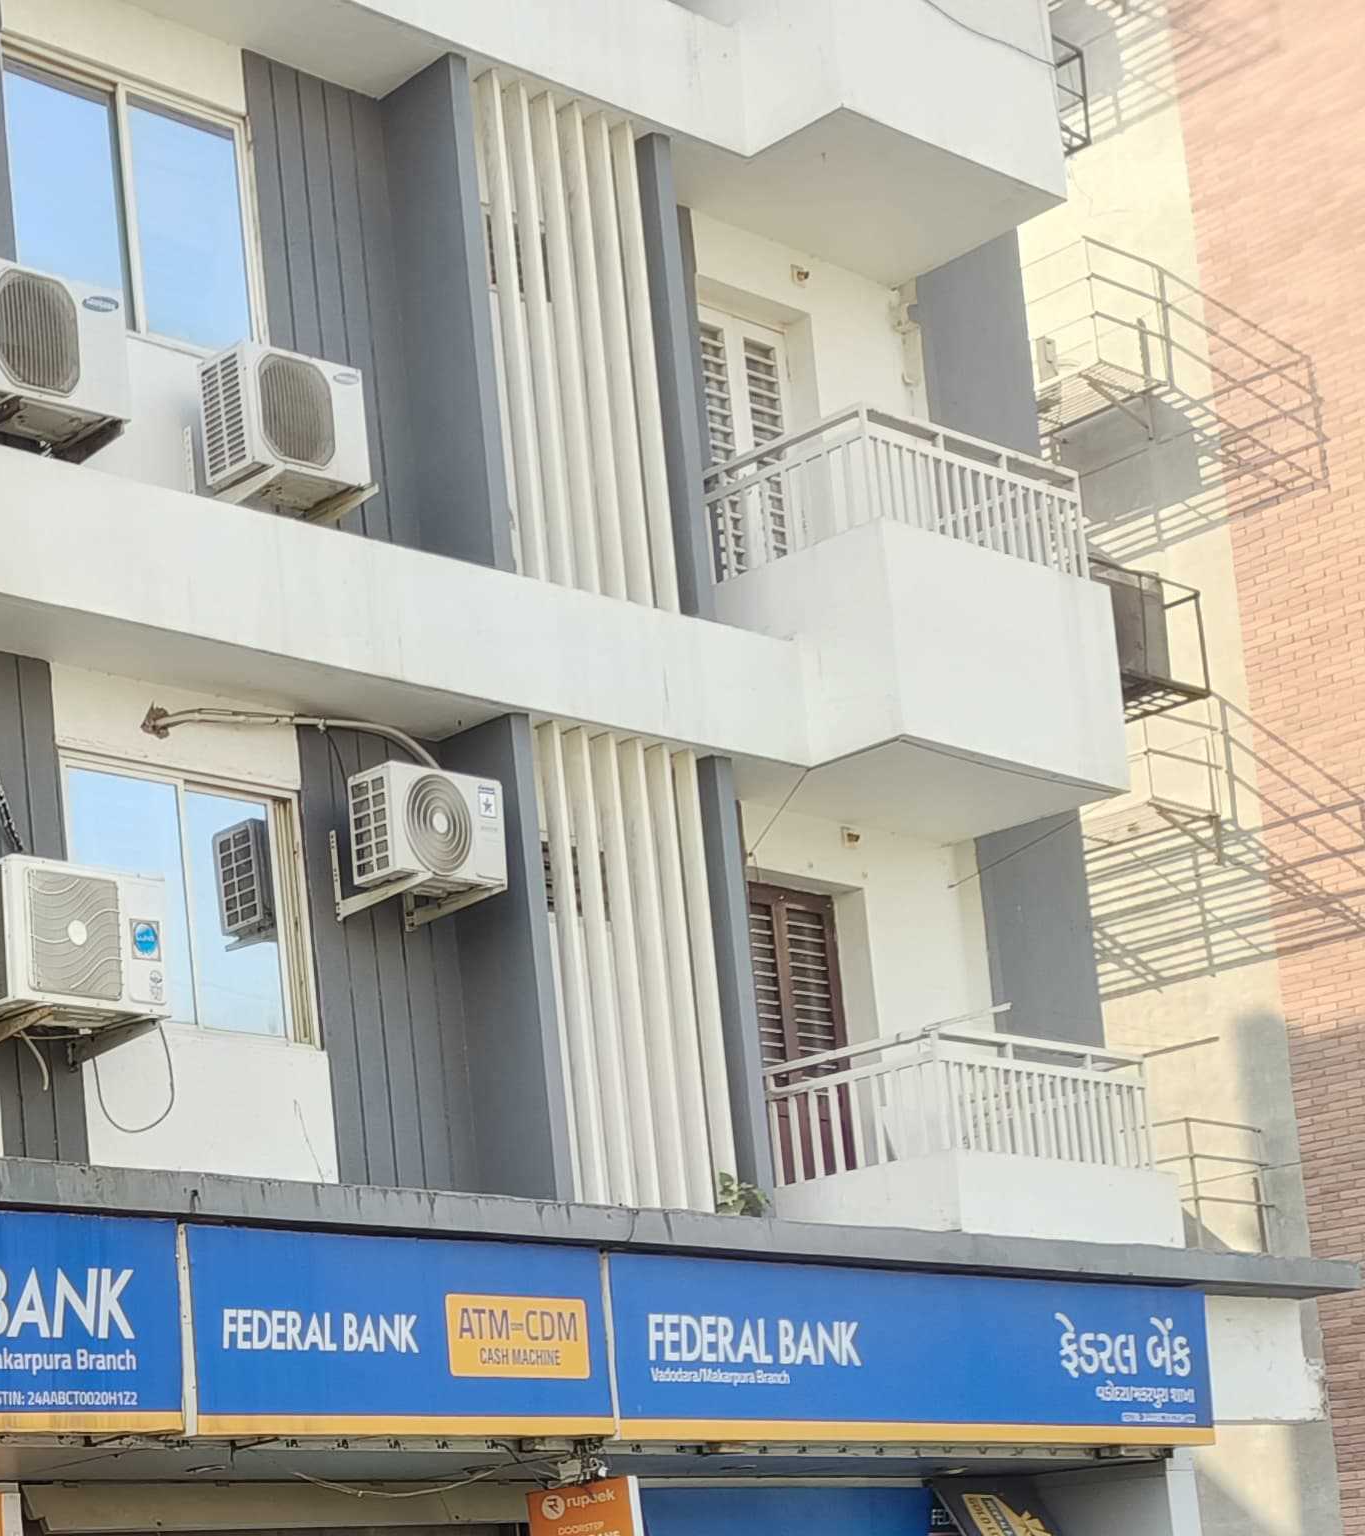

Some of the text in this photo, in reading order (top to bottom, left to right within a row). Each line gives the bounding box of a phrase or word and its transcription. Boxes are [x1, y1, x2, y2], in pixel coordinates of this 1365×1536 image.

[222, 1308, 419, 1355] FEDERAL BANK
[647, 1313, 862, 1367] FEDERAL BANK
[1054, 1312, 1191, 1379] ફેડરલ બેંક
[76, 1347, 137, 1372] Branch
[479, 1347, 562, 1368] CASH MACHINE
[650, 1367, 791, 1387] Vadodara/Makarpura Branch
[967, 1496, 990, 1528] GOLD
